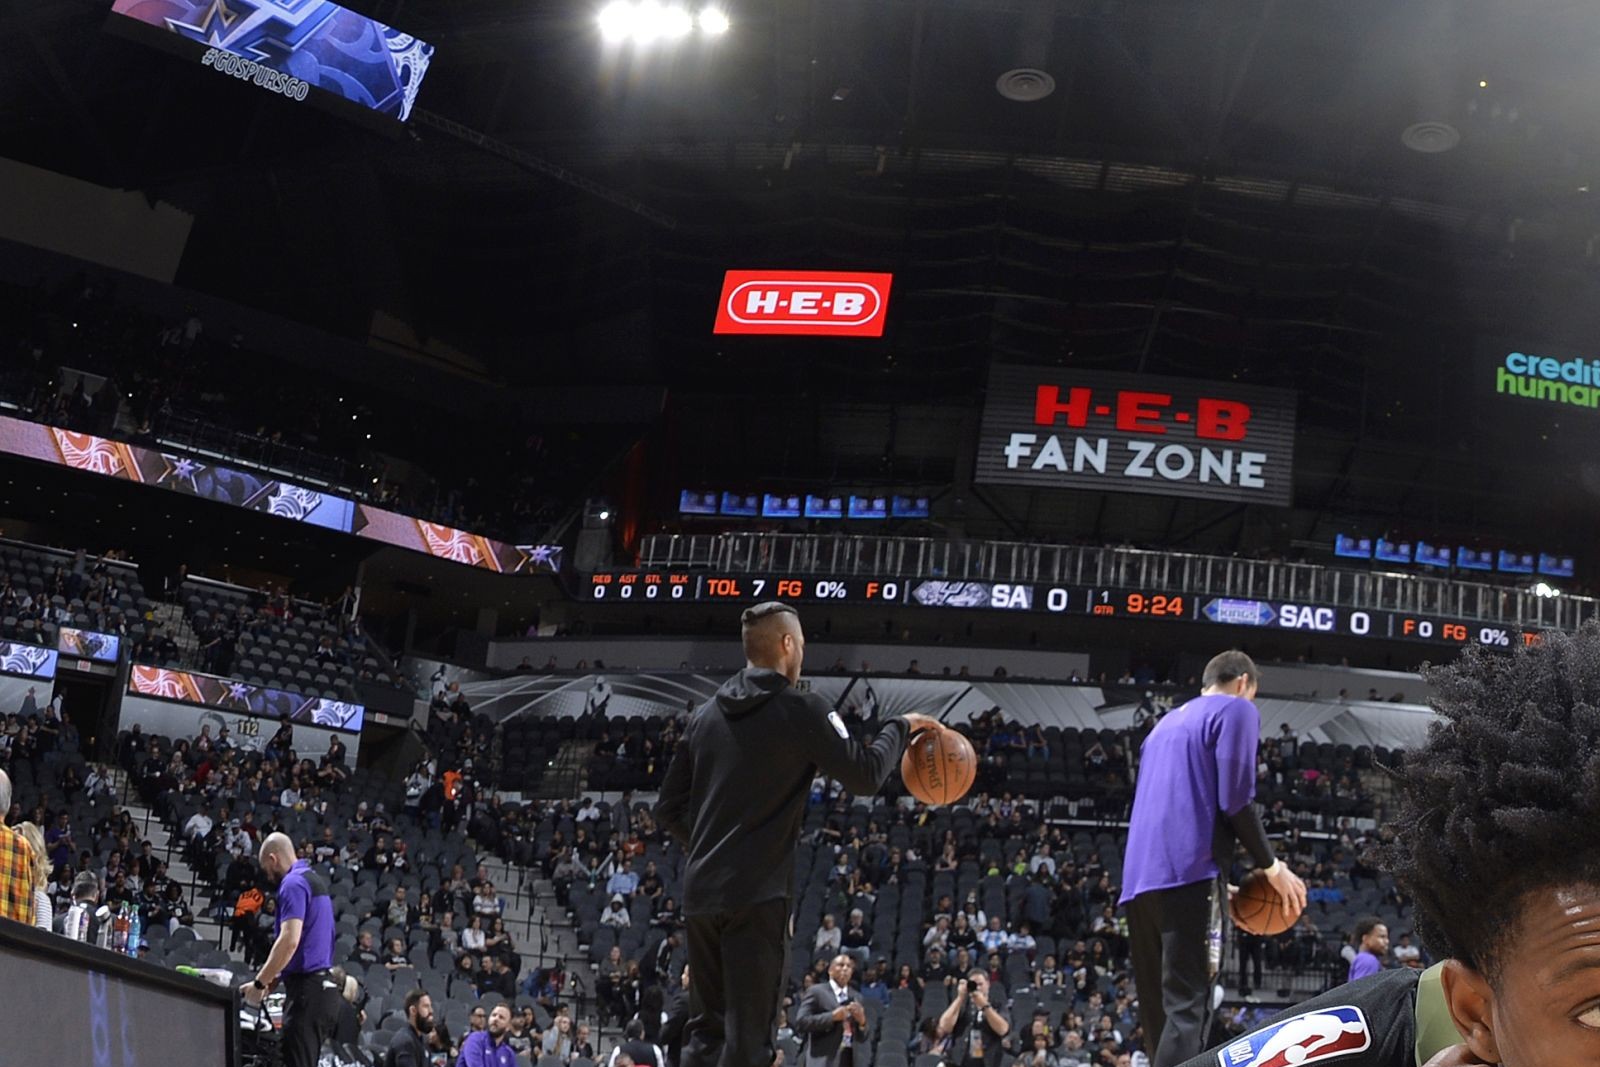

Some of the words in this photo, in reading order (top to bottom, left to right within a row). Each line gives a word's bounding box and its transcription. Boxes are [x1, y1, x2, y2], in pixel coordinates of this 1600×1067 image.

[201, 47, 309, 101] #GOSPURSGO
[1004, 433, 1108, 474] FAN
[1123, 439, 1267, 488] ZONE
[593, 585, 606, 599] 0
[620, 585, 632, 599] 0
[645, 585, 658, 599] 0
[671, 585, 683, 599] 0
[707, 579, 741, 596] TOL
[752, 579, 765, 597] 7
[777, 580, 802, 598] FG
[815, 581, 847, 598] 0%
[866, 582, 879, 599] F
[882, 583, 897, 600] 0
[990, 584, 1028, 609] SA
[1047, 588, 1068, 612] 0
[1101, 590, 1109, 603] 1
[1127, 593, 1184, 616] 9:24
[1279, 604, 1333, 631] SAC
[1350, 611, 1370, 635] 0
[1403, 619, 1416, 636] F
[1418, 621, 1433, 637] 0
[1442, 623, 1467, 641] FG
[1479, 628, 1510, 646] 0%
[238, 720, 259, 736] 112
